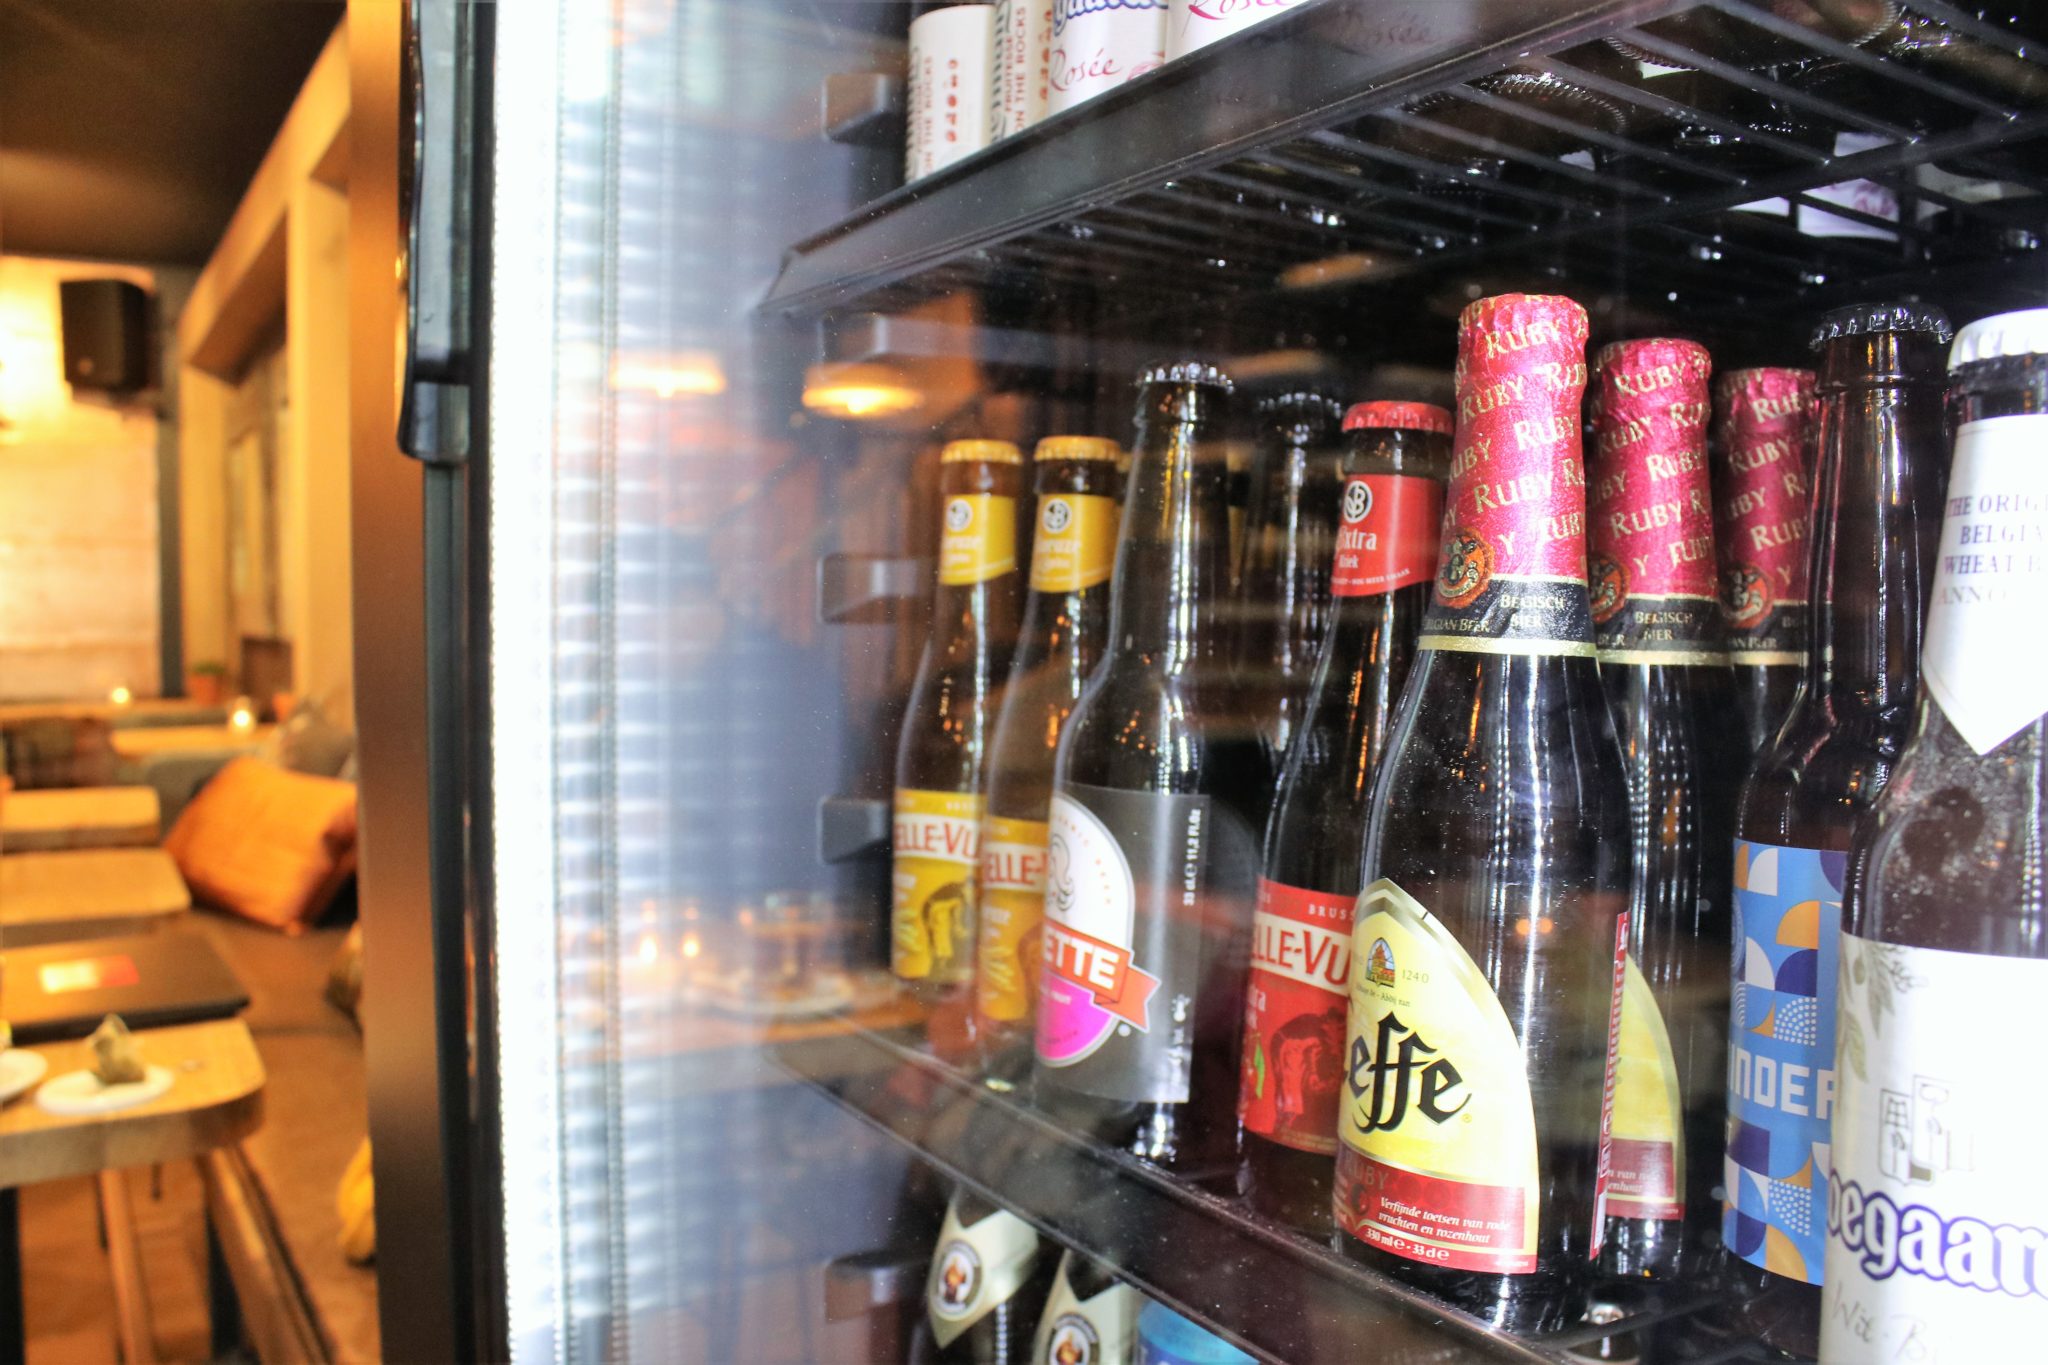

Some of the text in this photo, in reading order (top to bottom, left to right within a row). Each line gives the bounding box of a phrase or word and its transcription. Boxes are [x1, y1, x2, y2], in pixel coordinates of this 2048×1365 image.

[1015, 7, 1026, 64] ROCKS
[1050, 47, 1122, 92] Rosée
[1015, 72, 1026, 104] THE
[1485, 320, 1561, 359] RUBY
[1614, 362, 1686, 397] RUBY
[1461, 376, 1525, 425] RUBY
[1513, 415, 1576, 452] RUBY
[1472, 470, 1554, 515] RUBY
[1611, 500, 1683, 540] RUBY
[1943, 554, 2014, 575] WHEAT
[1402, 968, 1430, 983] 1240
[1378, 1211, 1491, 1244] vruchten en rozenhout
[1422, 1210, 1460, 1227] toetsen
[1462, 1218, 1484, 1230] van
[1412, 1244, 1425, 1257] 33
